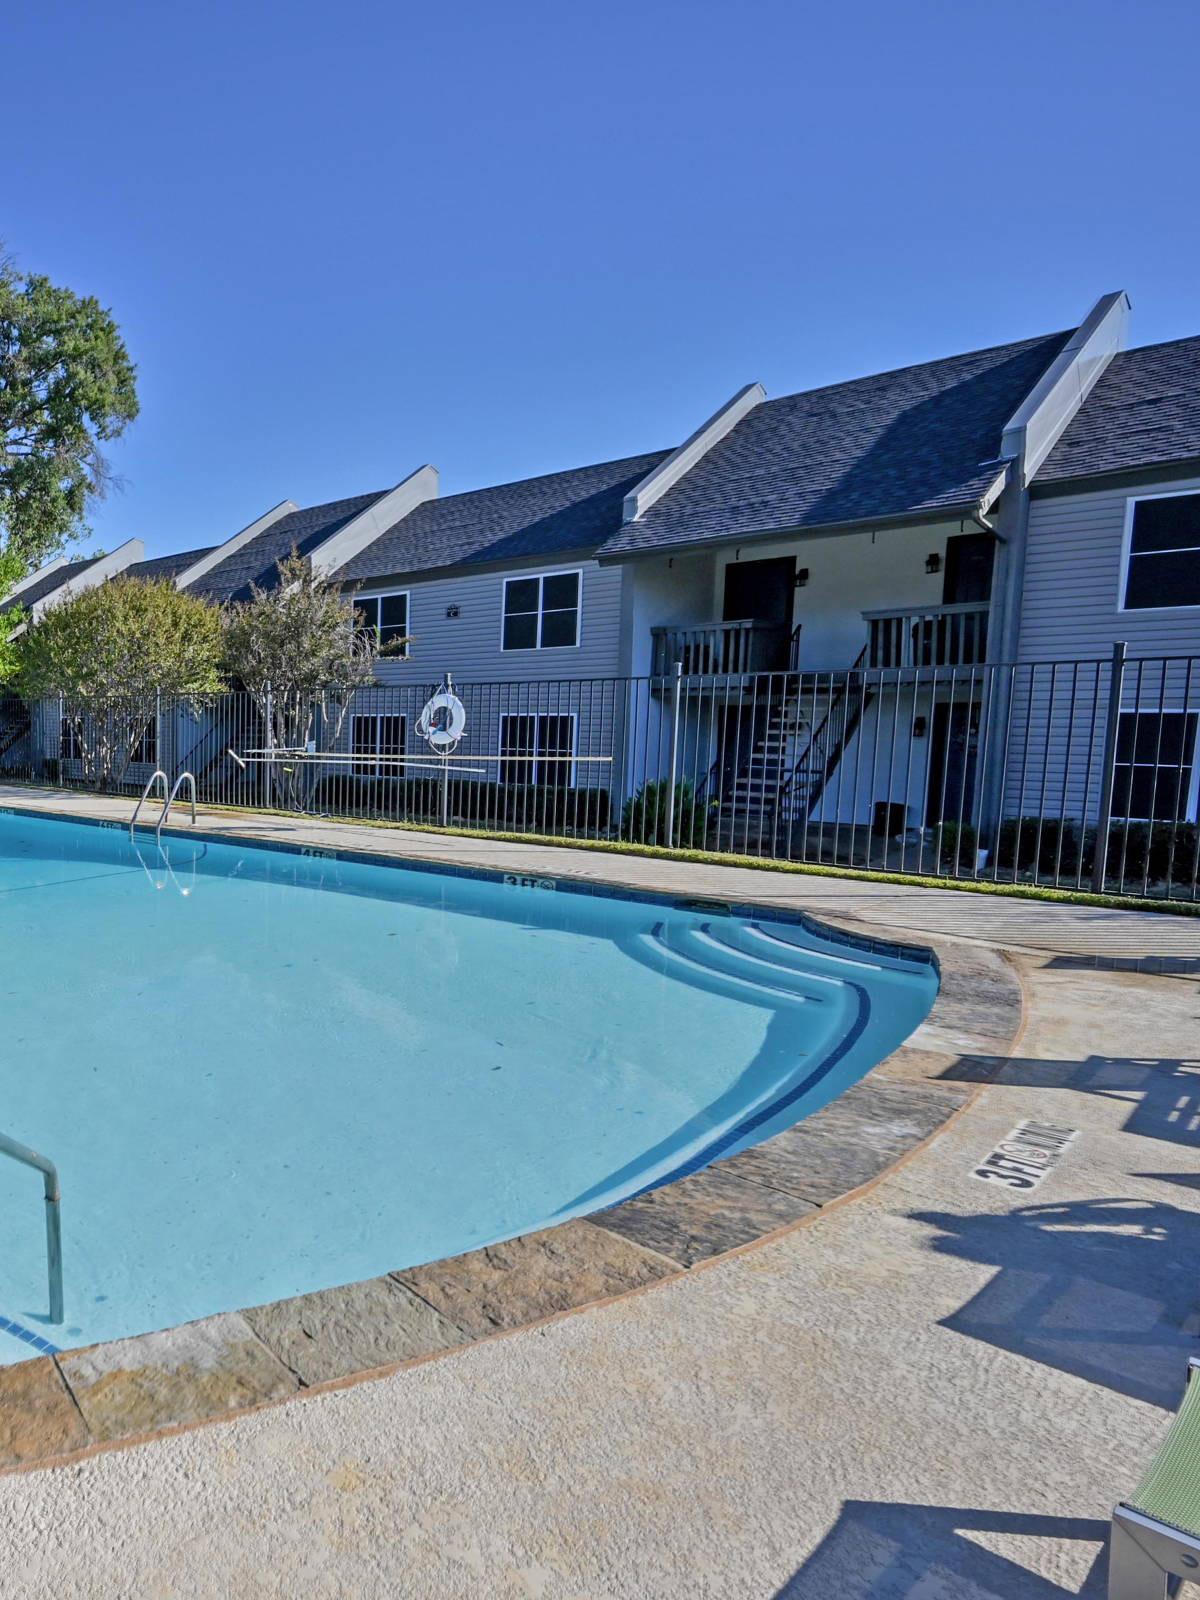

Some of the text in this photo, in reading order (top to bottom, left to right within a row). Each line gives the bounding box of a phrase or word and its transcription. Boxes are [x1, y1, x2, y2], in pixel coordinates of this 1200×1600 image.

[521, 878, 537, 888] FT
[986, 1152, 1046, 1178] FT
[975, 1169, 1035, 1188] 3
